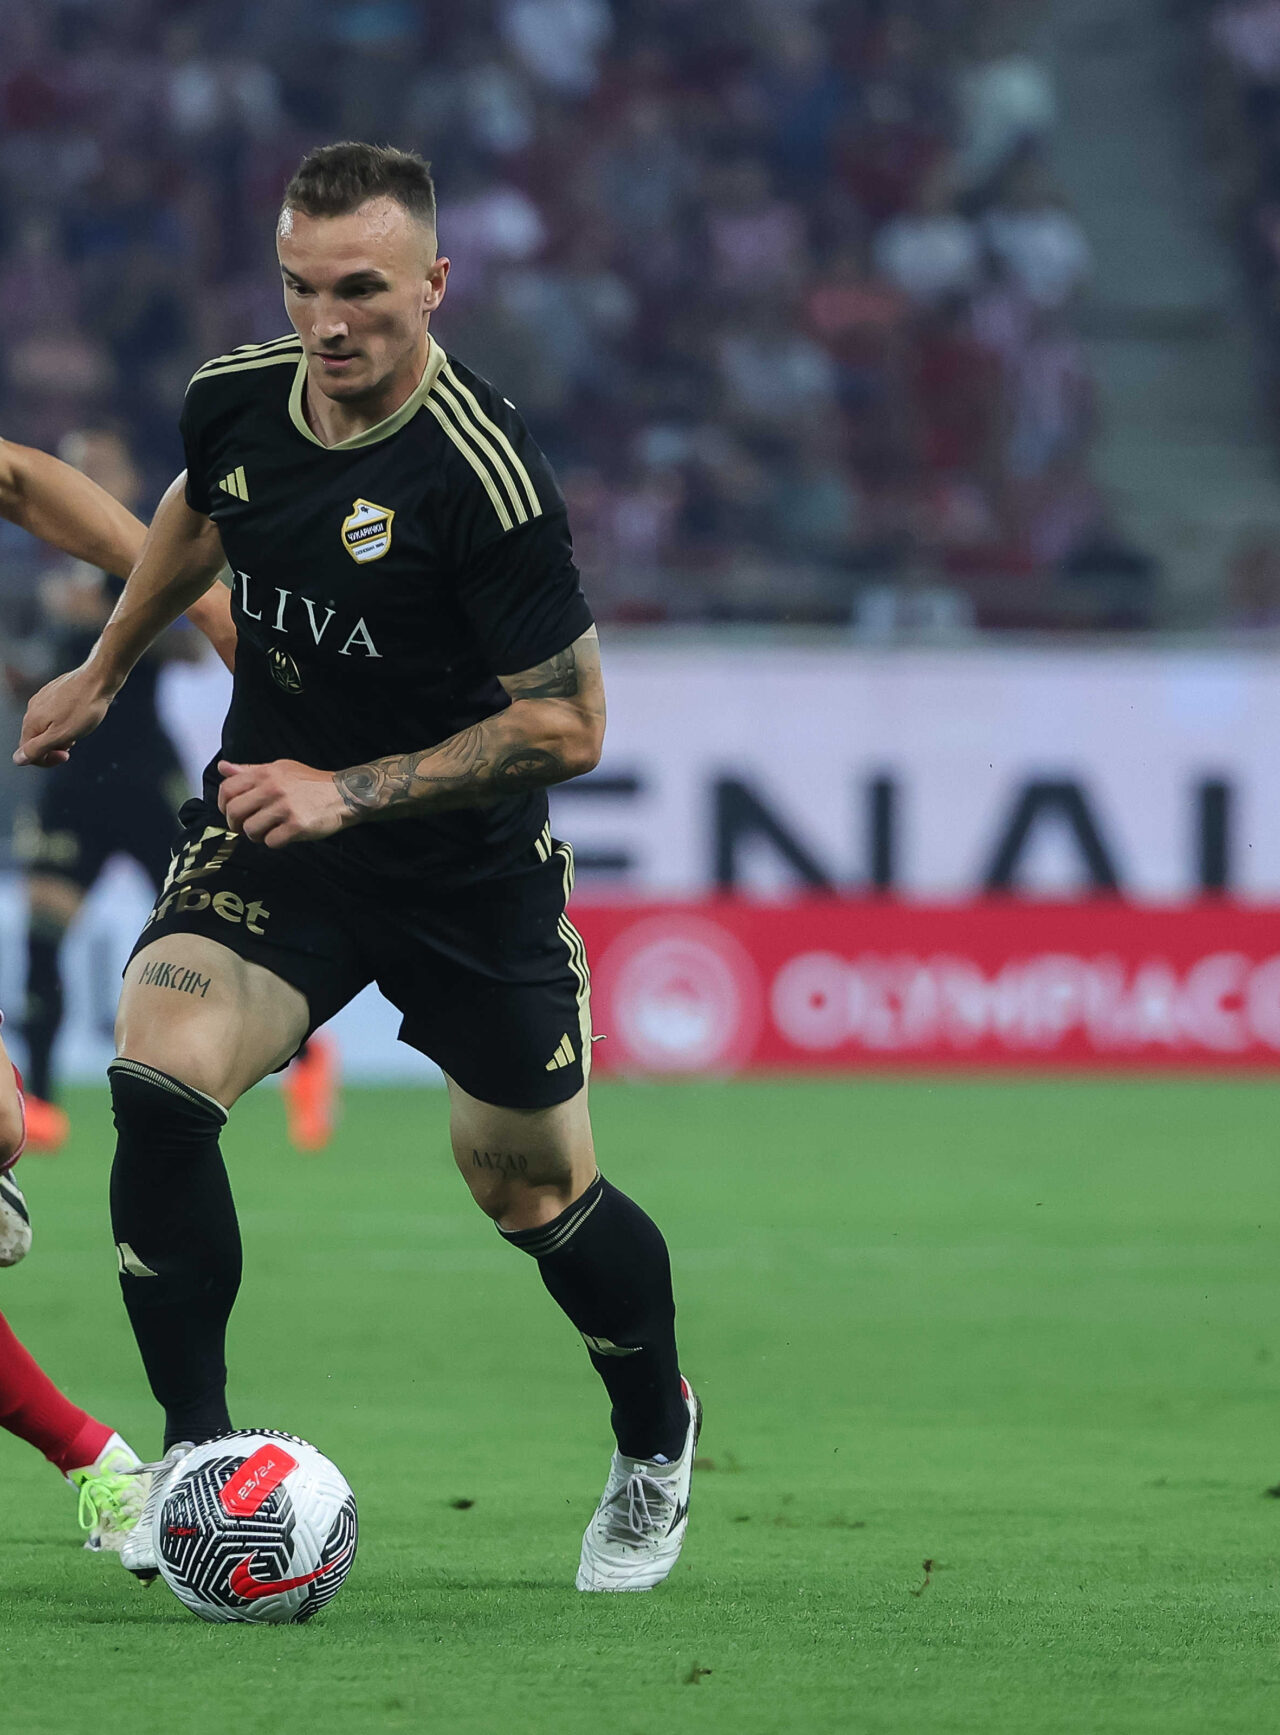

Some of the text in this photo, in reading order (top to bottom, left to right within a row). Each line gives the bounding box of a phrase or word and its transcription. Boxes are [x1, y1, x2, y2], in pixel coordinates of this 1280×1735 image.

[232, 569, 383, 658] LIVA
[142, 885, 270, 936] rbet
[237, 1459, 276, 1500] 23/24
